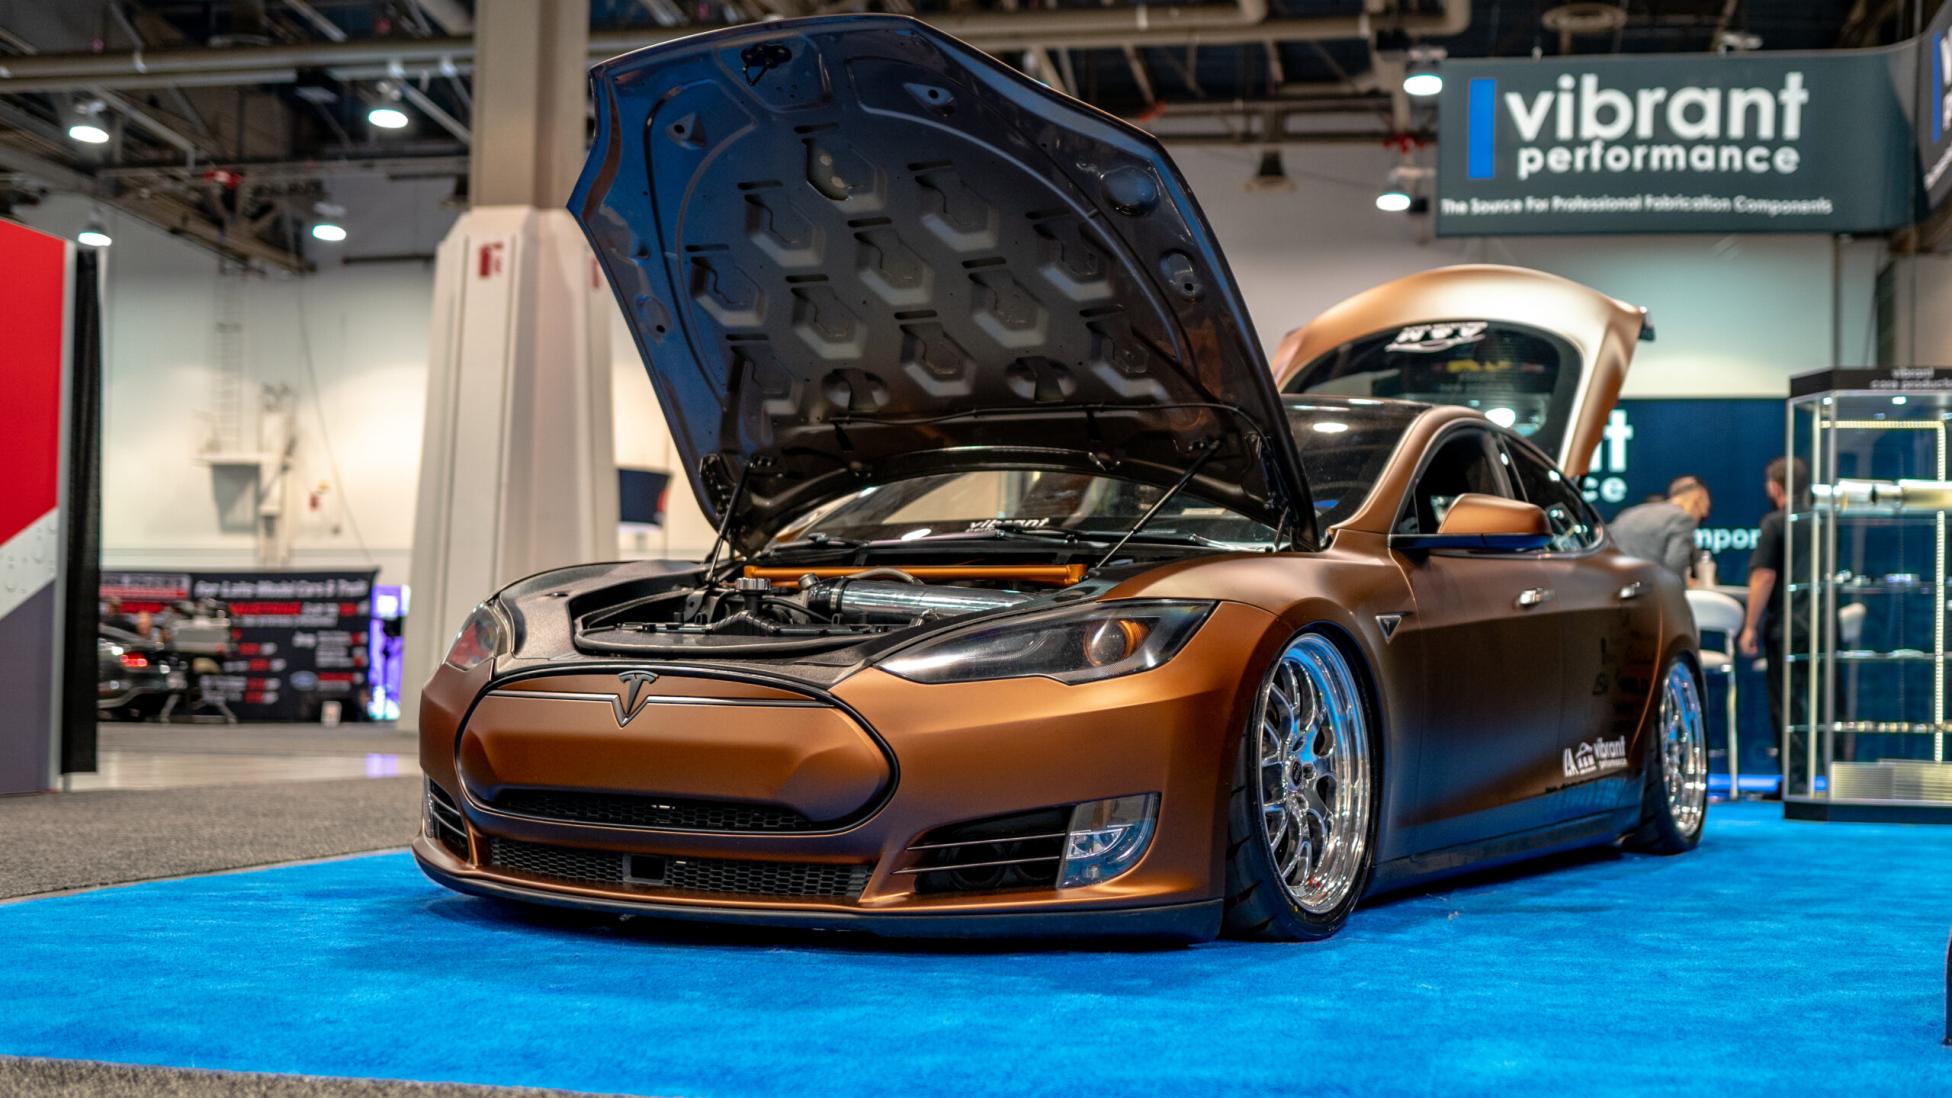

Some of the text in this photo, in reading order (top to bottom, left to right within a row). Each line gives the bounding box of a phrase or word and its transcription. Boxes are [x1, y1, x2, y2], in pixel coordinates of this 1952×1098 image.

[1505, 72, 1808, 140] vibrant
[1518, 140, 1800, 180] performance
[1441, 193, 1833, 217] The Source For Professional Fabrication Components
[1594, 735, 1626, 759] vibrant
